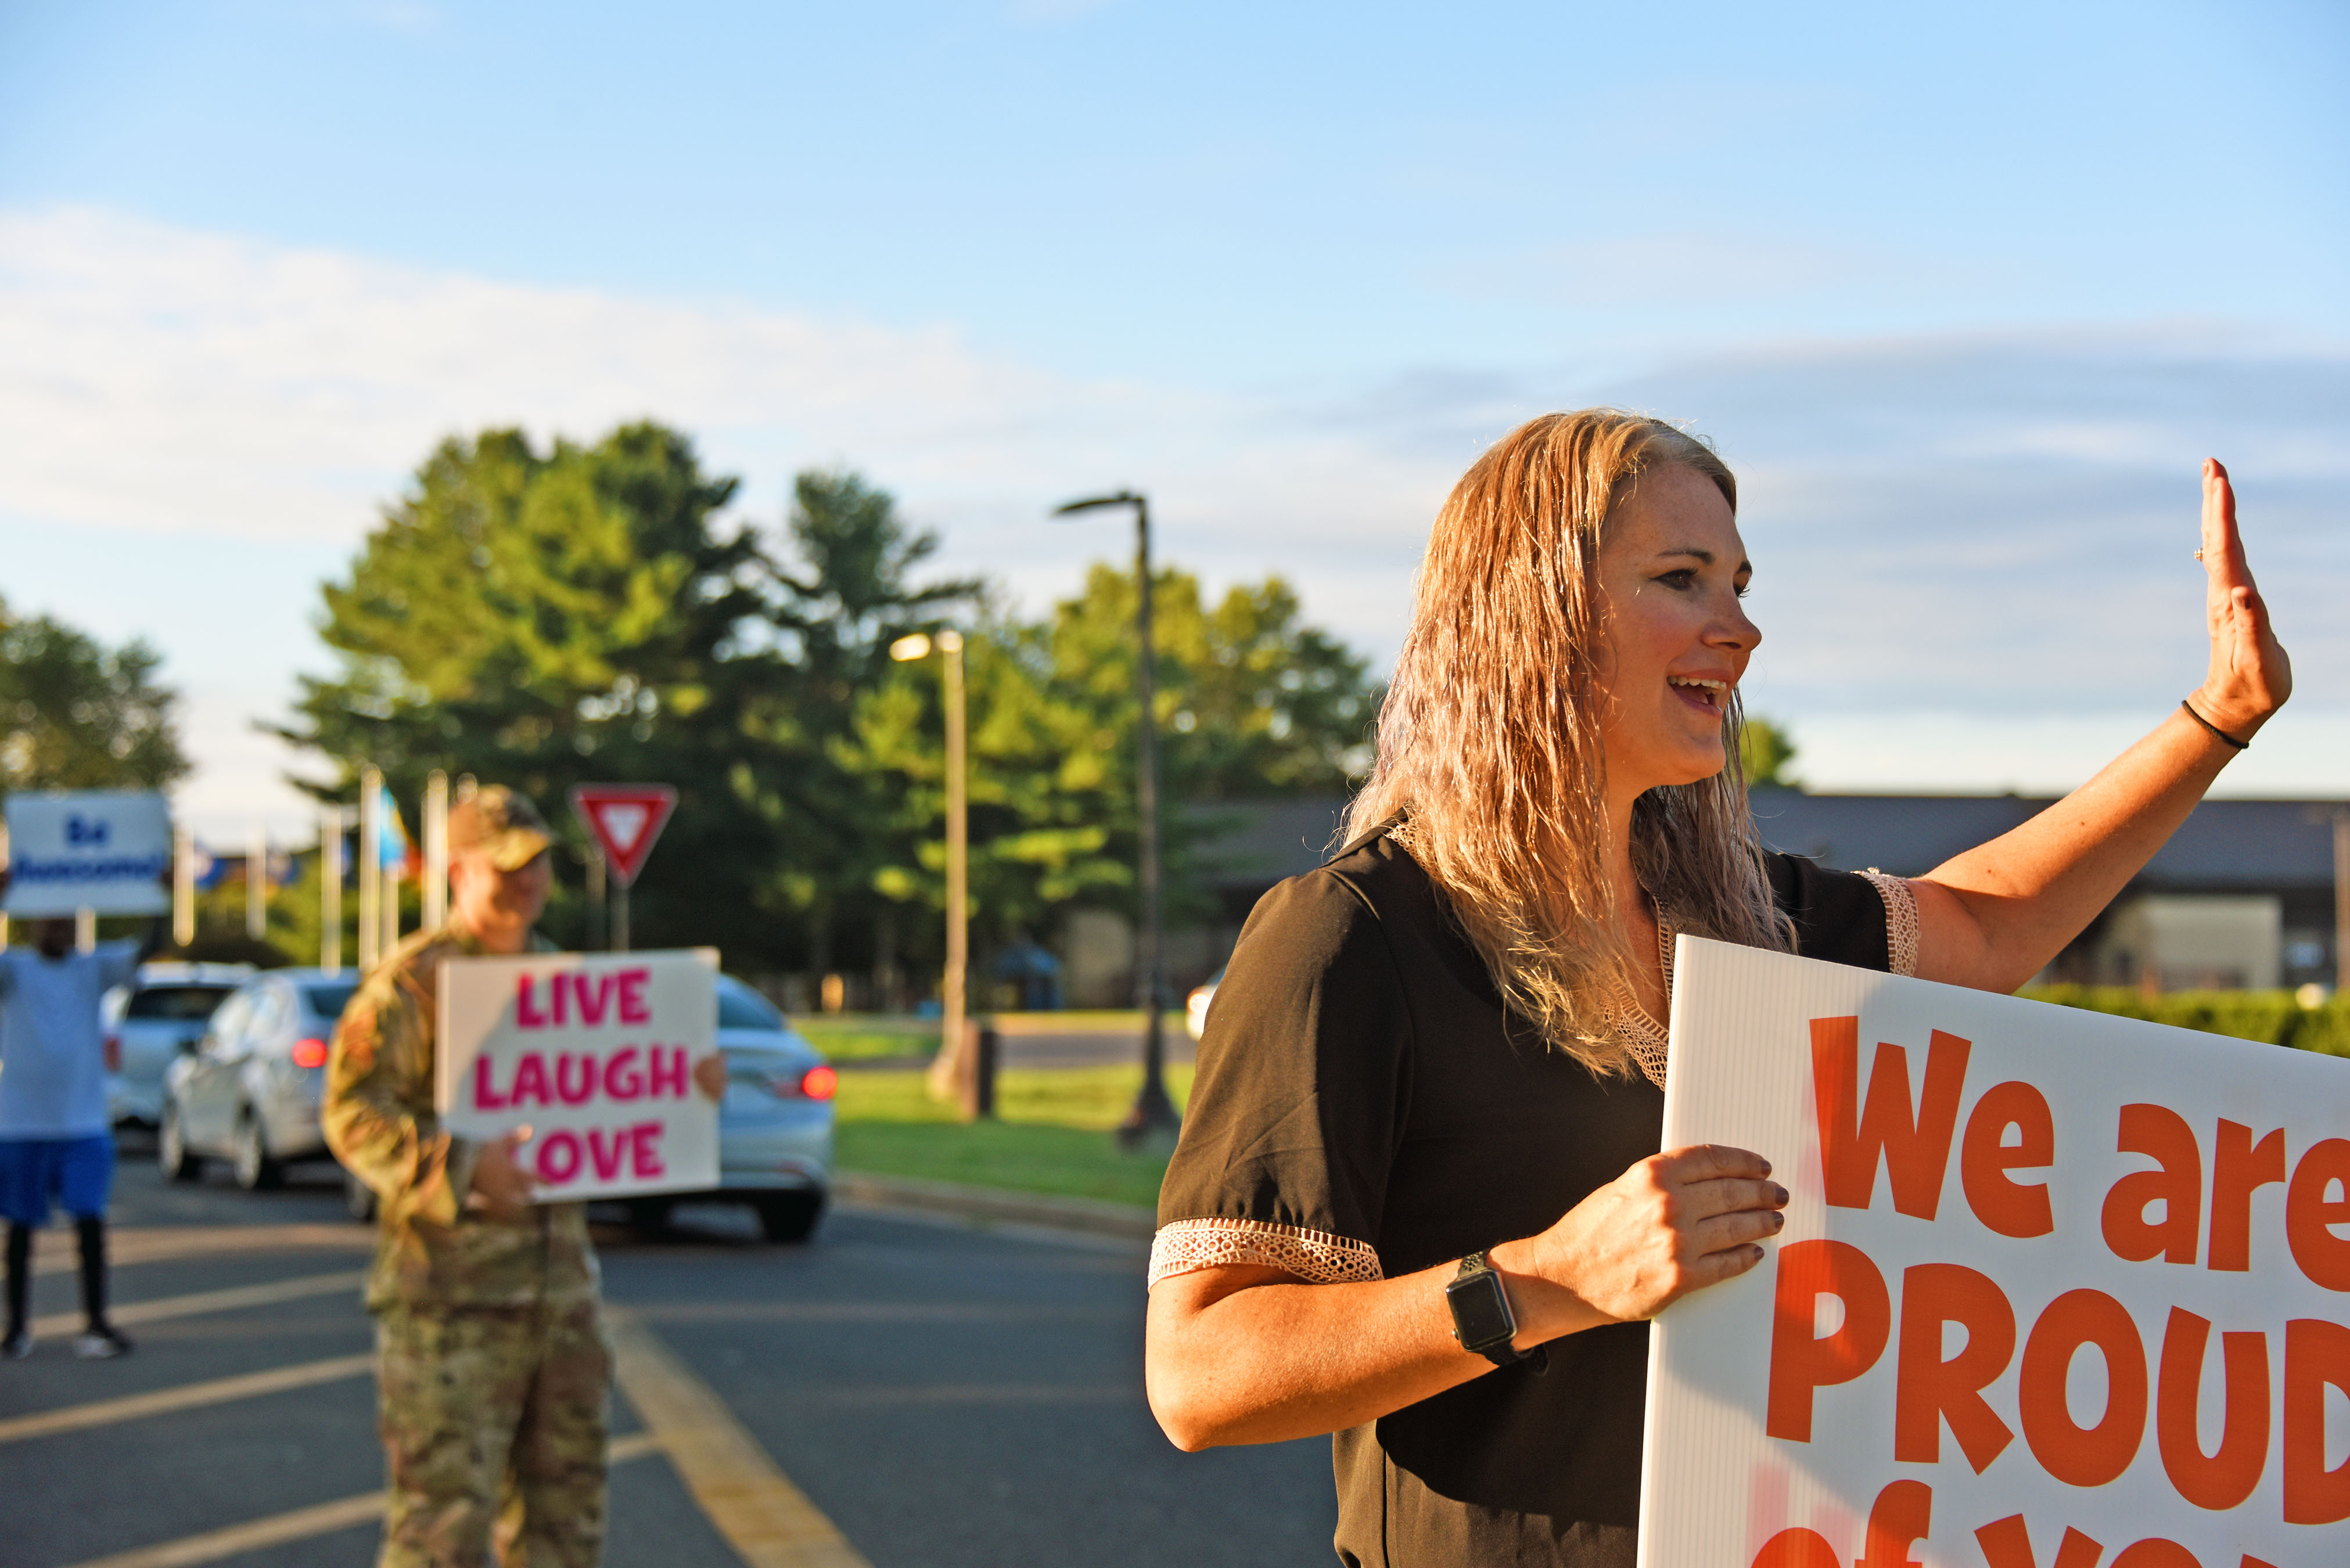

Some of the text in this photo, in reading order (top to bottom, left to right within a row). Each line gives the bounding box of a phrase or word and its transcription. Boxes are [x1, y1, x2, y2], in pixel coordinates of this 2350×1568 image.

[516, 966, 652, 1028] LIVE
[473, 1044, 690, 1112] LAUGH
[517, 1120, 666, 1186] OVE
[1809, 1015, 2350, 1292] We are
